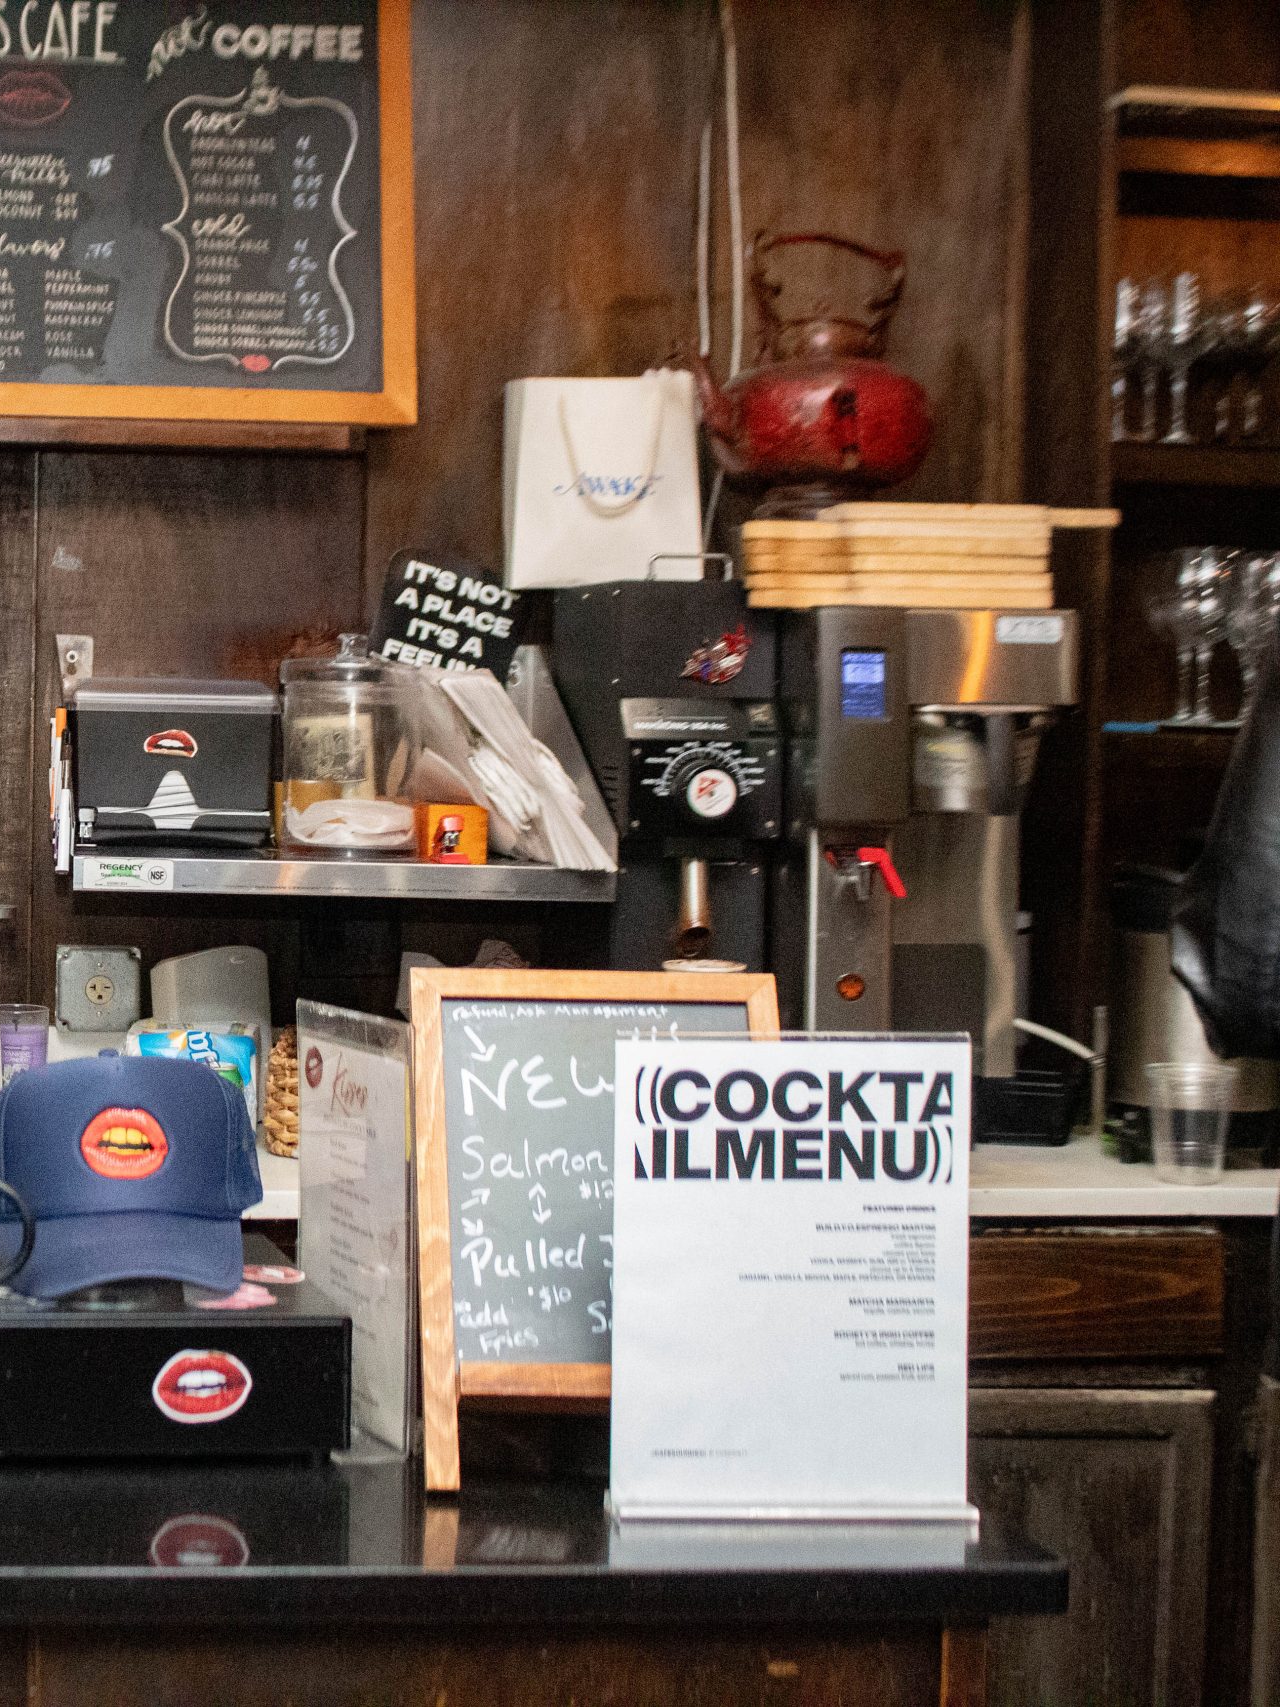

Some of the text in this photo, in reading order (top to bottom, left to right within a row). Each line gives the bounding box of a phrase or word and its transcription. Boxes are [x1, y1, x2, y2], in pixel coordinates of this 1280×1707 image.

[20, 0, 119, 63] CAFE
[211, 23, 365, 63] COFFEE
[47, 346, 95, 359] VANILLA
[404, 560, 521, 610] IT'S NOT
[394, 587, 515, 639] A PLACE
[406, 617, 483, 659] IT'S A
[99, 863, 144, 871] REGENCY
[150, 871, 165, 880] NSF
[461, 1135, 609, 1181] Salmon
[460, 1232, 587, 1288] Pulled
